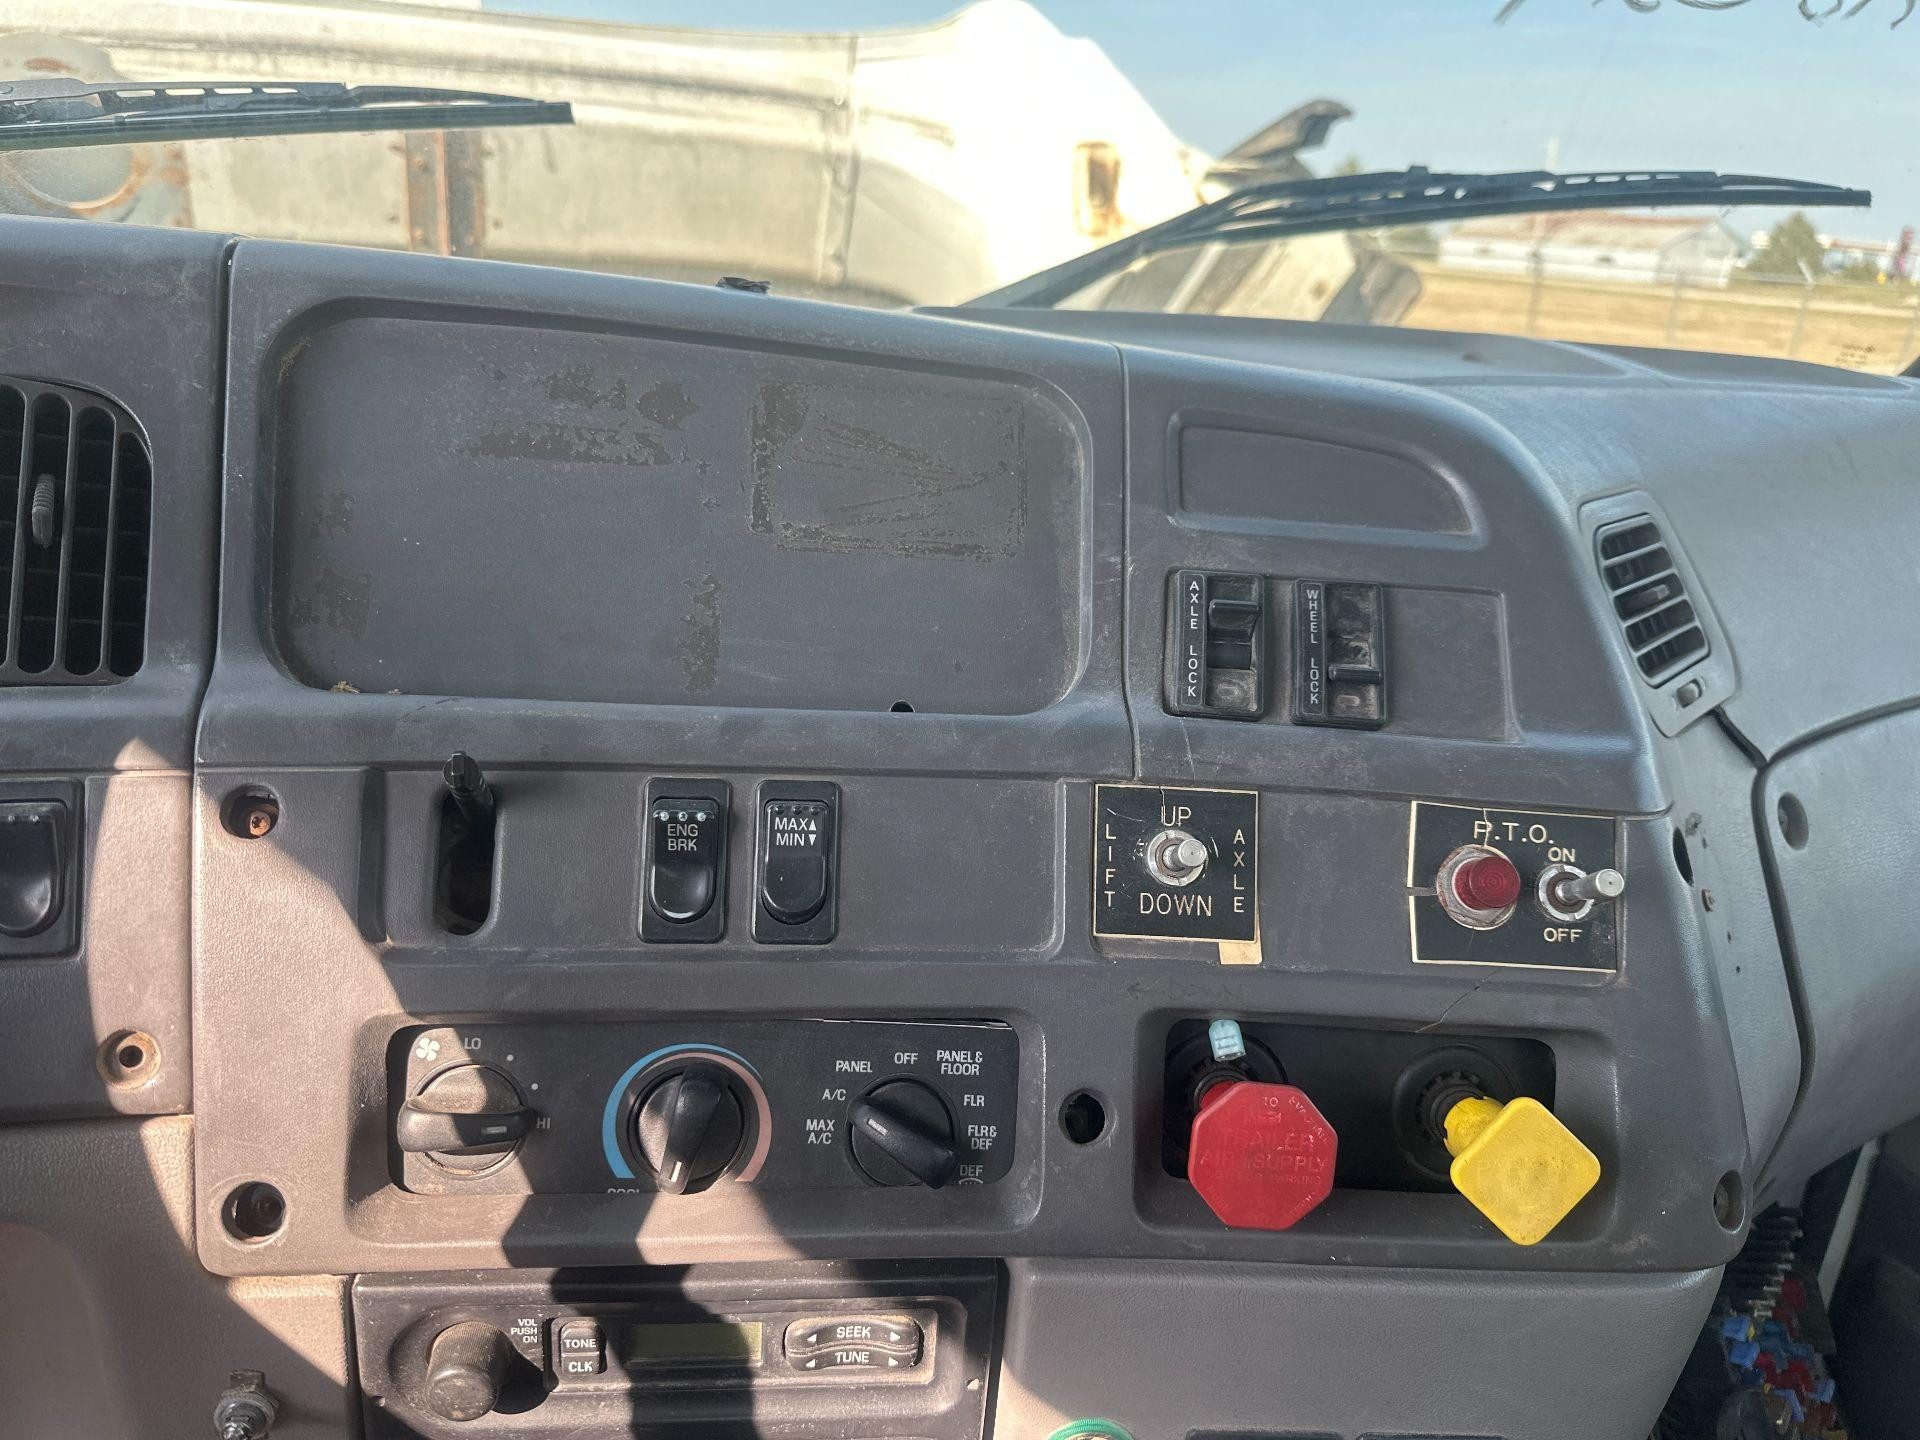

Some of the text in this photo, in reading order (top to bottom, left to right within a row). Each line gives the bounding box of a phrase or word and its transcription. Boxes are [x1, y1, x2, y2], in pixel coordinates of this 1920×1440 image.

[1187, 580, 1200, 697] AXLE LOCK
[1306, 589, 1320, 704] WHEEL LOCK
[1161, 806, 1192, 827] UP
[667, 823, 699, 837] ENG
[774, 817, 808, 831] MAX
[1473, 820, 1555, 845] P.T.O.
[667, 838, 698, 851] BRK
[775, 833, 805, 847] MIN
[1547, 846, 1576, 863] ON
[1104, 823, 1117, 908] LIFT
[1233, 828, 1246, 913] AXLE
[1139, 892, 1212, 917] DOWN
[1543, 927, 1583, 943] OFF
[464, 1037, 482, 1051] LO
[894, 1052, 919, 1065] OFF
[936, 1050, 973, 1063] PANEL
[835, 1060, 873, 1073] PANEL
[940, 1063, 980, 1076] FLOOR
[822, 1088, 847, 1101] A/C
[963, 1094, 985, 1107] FLR
[536, 1116, 551, 1130] HI
[806, 1118, 835, 1132] MAX
[807, 1132, 832, 1145] A/C
[971, 1138, 993, 1150] DEF
[959, 1164, 984, 1177] DEF
[518, 1319, 537, 1327] VOL
[510, 1327, 538, 1336] PUSH
[836, 1325, 872, 1340] SEEK
[523, 1336, 538, 1344] ON
[564, 1338, 596, 1348] TONE
[834, 1350, 870, 1364] TUNE
[568, 1361, 593, 1373] CLK
